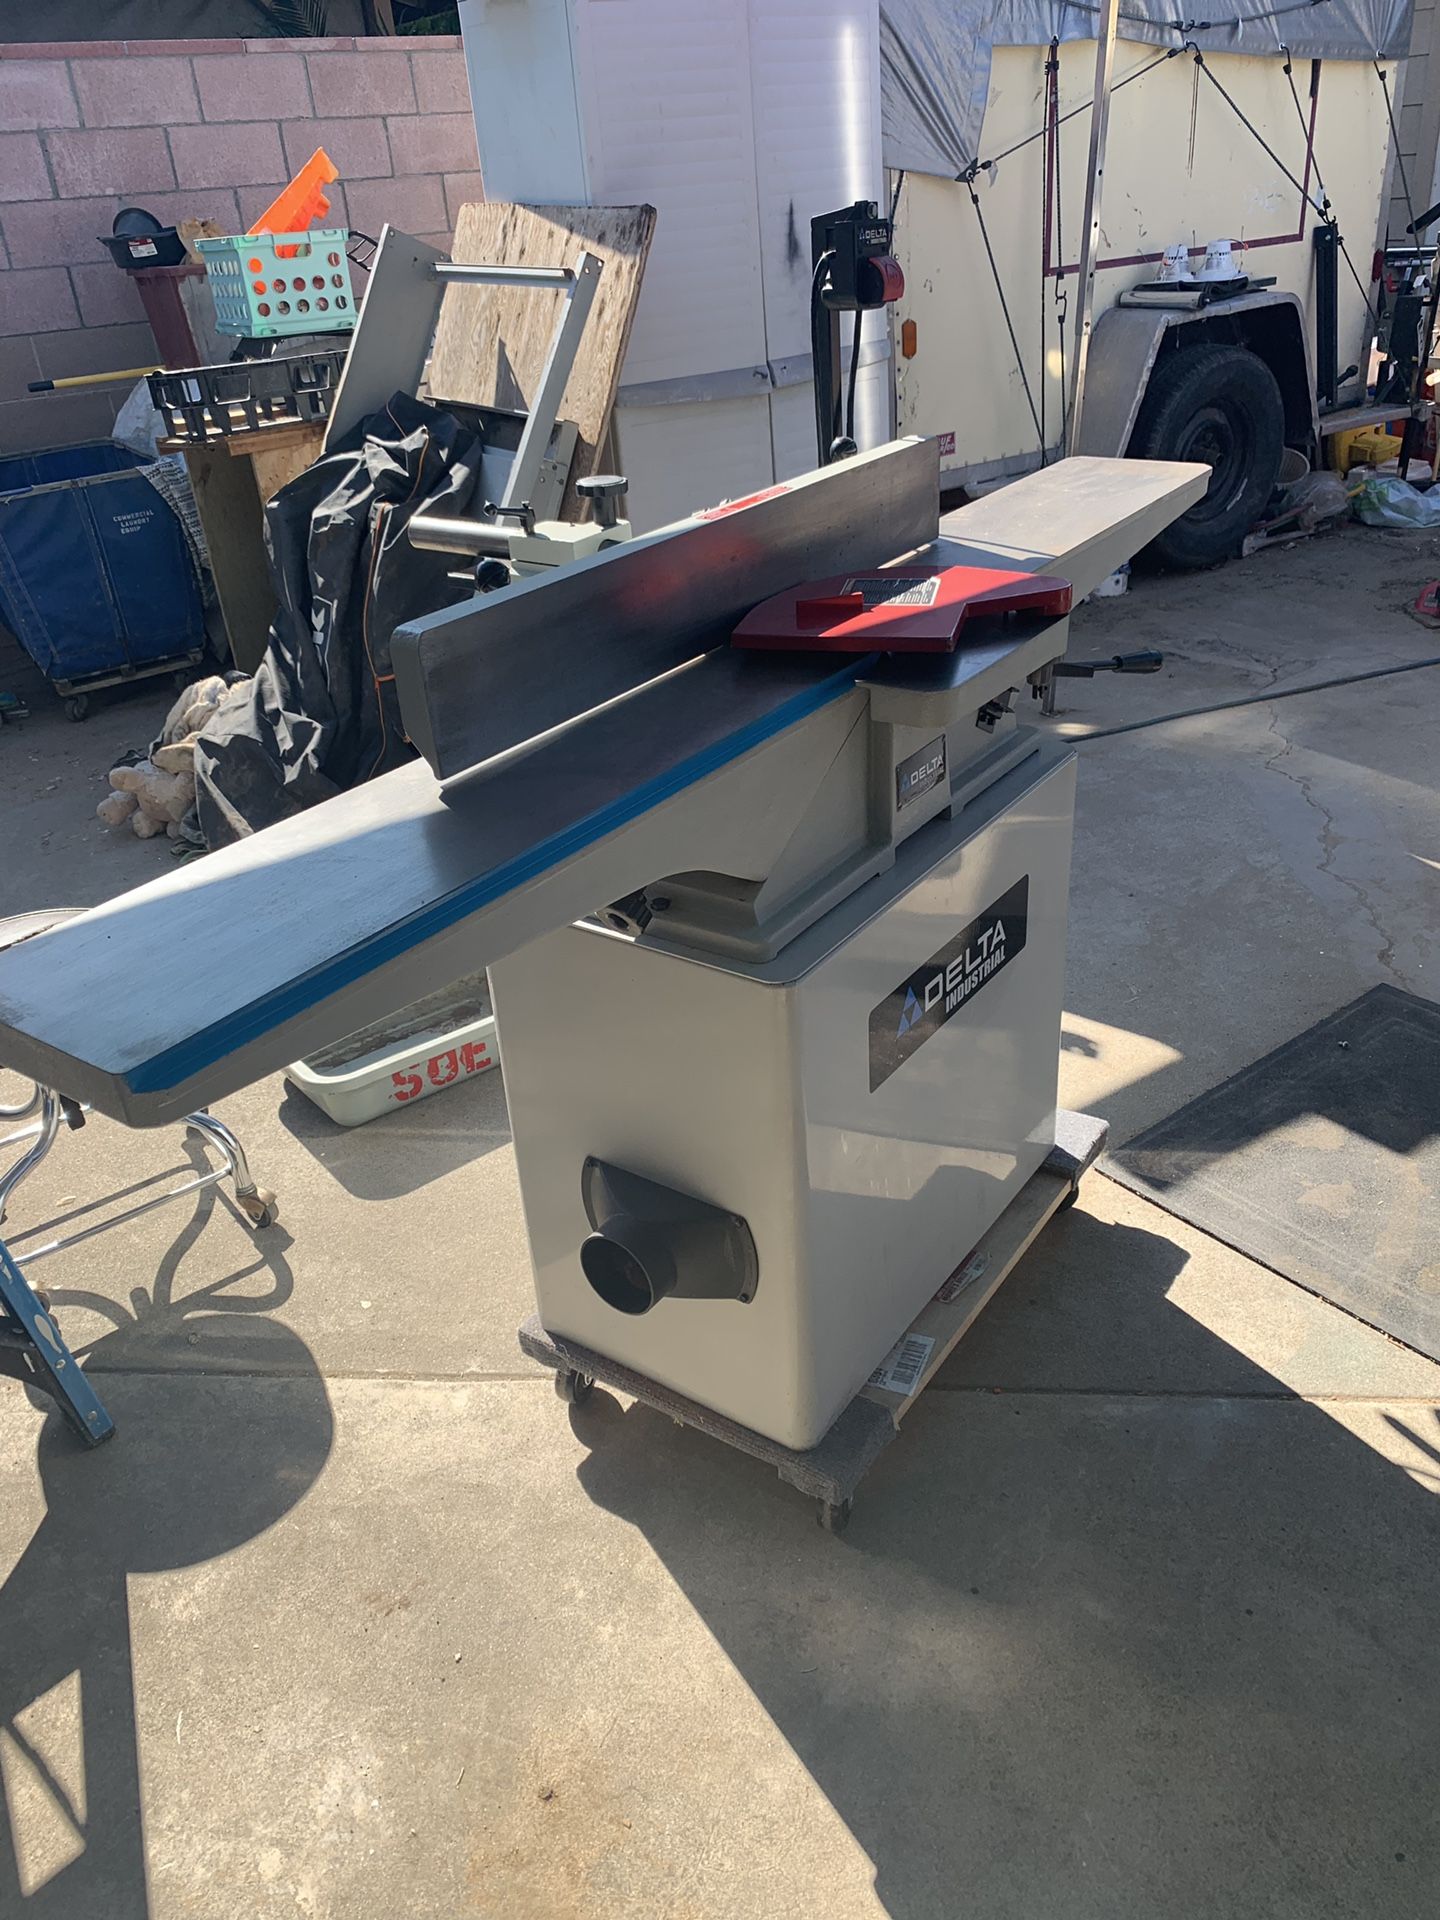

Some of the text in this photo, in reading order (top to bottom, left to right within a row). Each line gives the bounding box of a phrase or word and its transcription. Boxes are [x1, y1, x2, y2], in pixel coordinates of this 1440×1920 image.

[865, 228, 887, 239] DELTA
[910, 754, 944, 786] DELTA
[924, 919, 1007, 1013] DELTA
[946, 944, 1006, 1014] INDUSTRIAL
